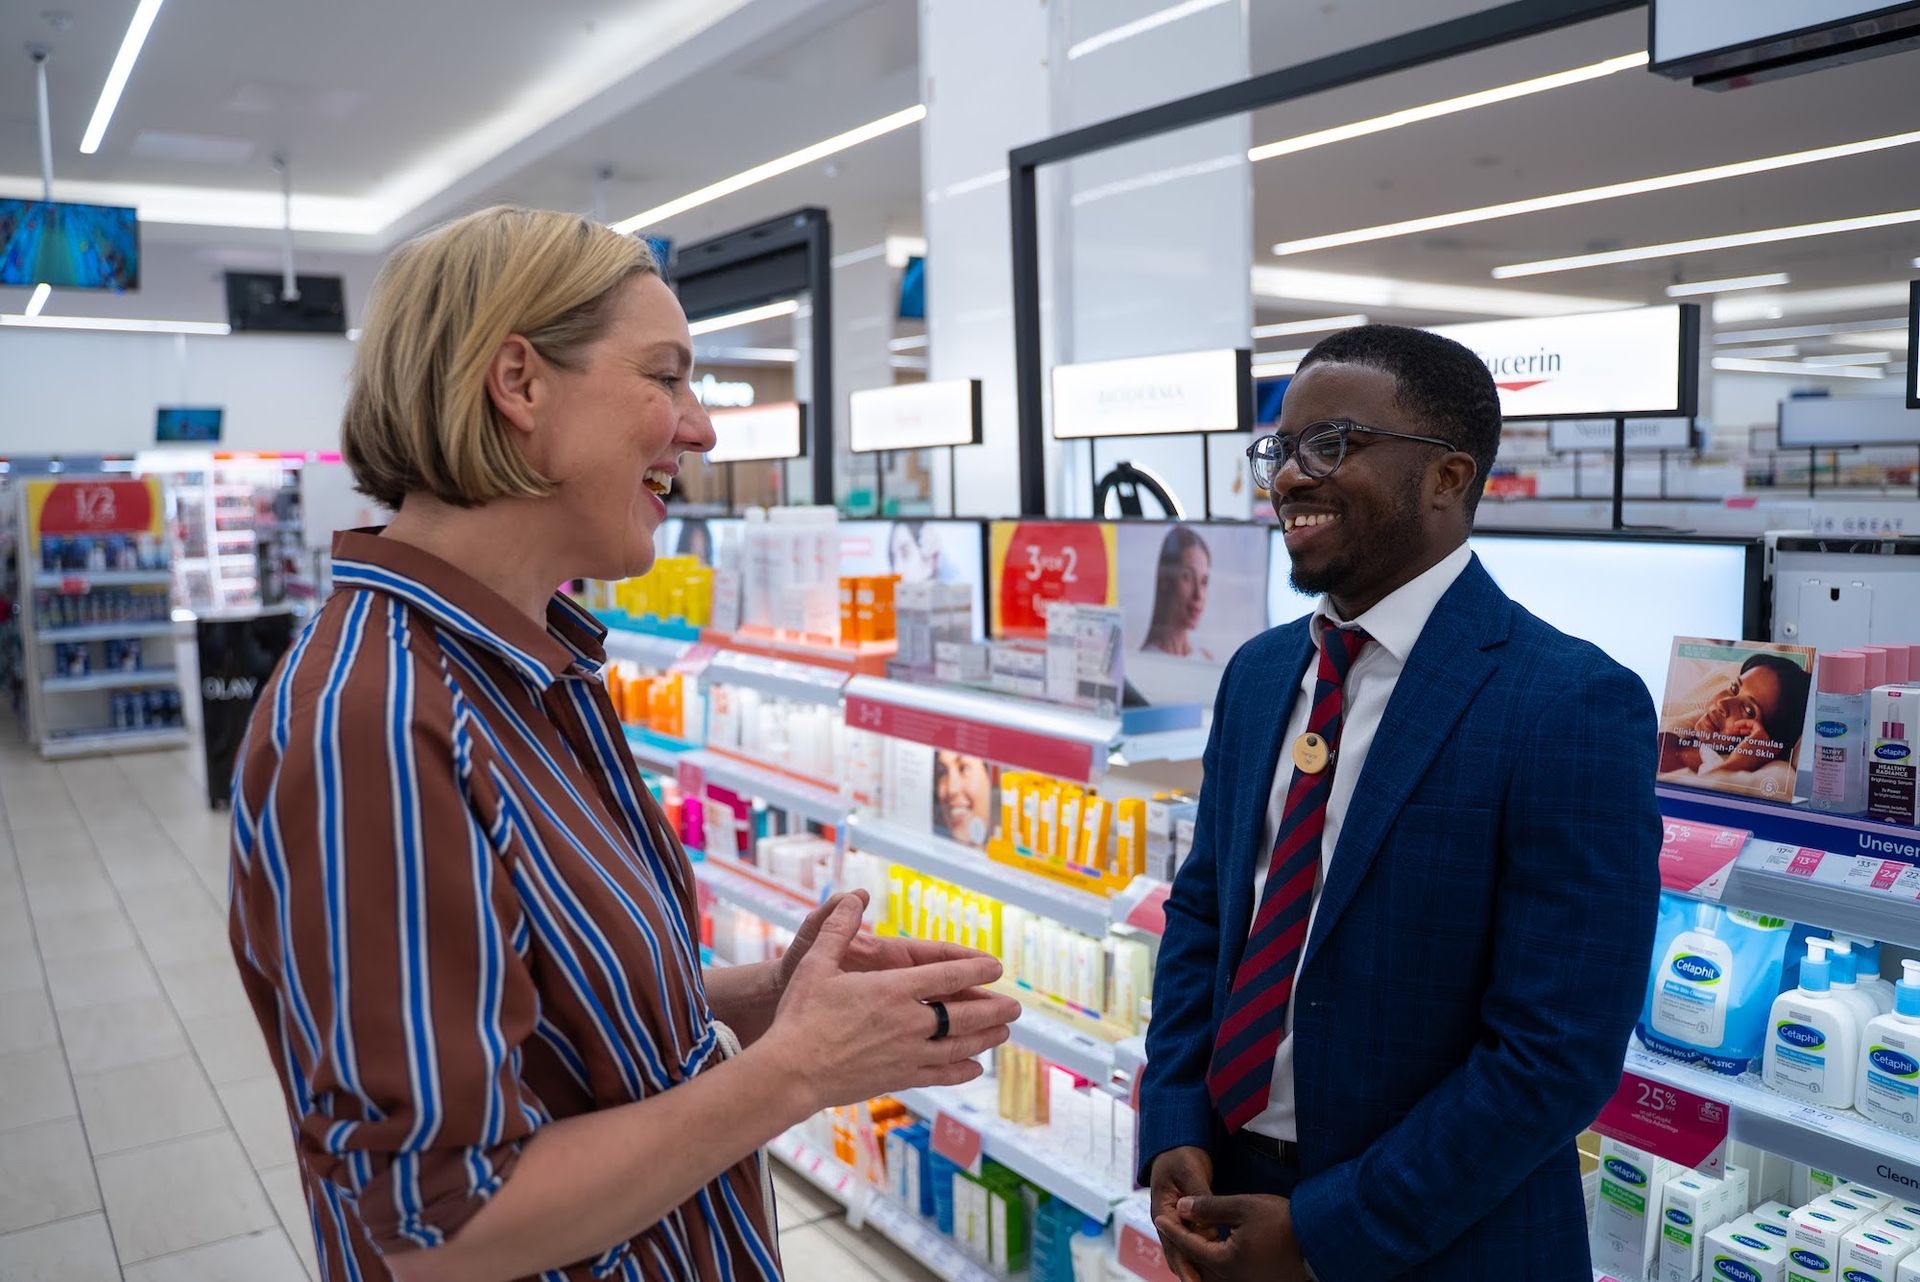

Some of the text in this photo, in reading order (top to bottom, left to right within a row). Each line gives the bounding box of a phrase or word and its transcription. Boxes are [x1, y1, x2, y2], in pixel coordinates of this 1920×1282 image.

[1482, 346, 1561, 376] ucerin
[1025, 545, 1041, 582] 3
[1061, 545, 1079, 583] 2
[1673, 726, 1784, 749] Clinically Proven Formulas
[1678, 738, 1775, 759] for Blemish-Prone Skin
[1877, 747, 1907, 757] Cetaphil
[1875, 769, 1909, 777] RADIANCE
[1878, 764, 1906, 772] HEALTHY
[1663, 823, 1691, 843] 5%
[1676, 959, 1715, 980] Cetaphil
[1781, 1026, 1819, 1045] Cetaphil
[1873, 1052, 1913, 1073] Cetaphil
[1636, 1082, 1677, 1111] 25%
[1607, 1160, 1642, 1183] Cetaphil
[1877, 1164, 1920, 1190] Clean
[1760, 1223, 1787, 1237] Cetaph
[1792, 1251, 1826, 1268] Cetaphil
[1718, 1261, 1756, 1282] Cetaphil
